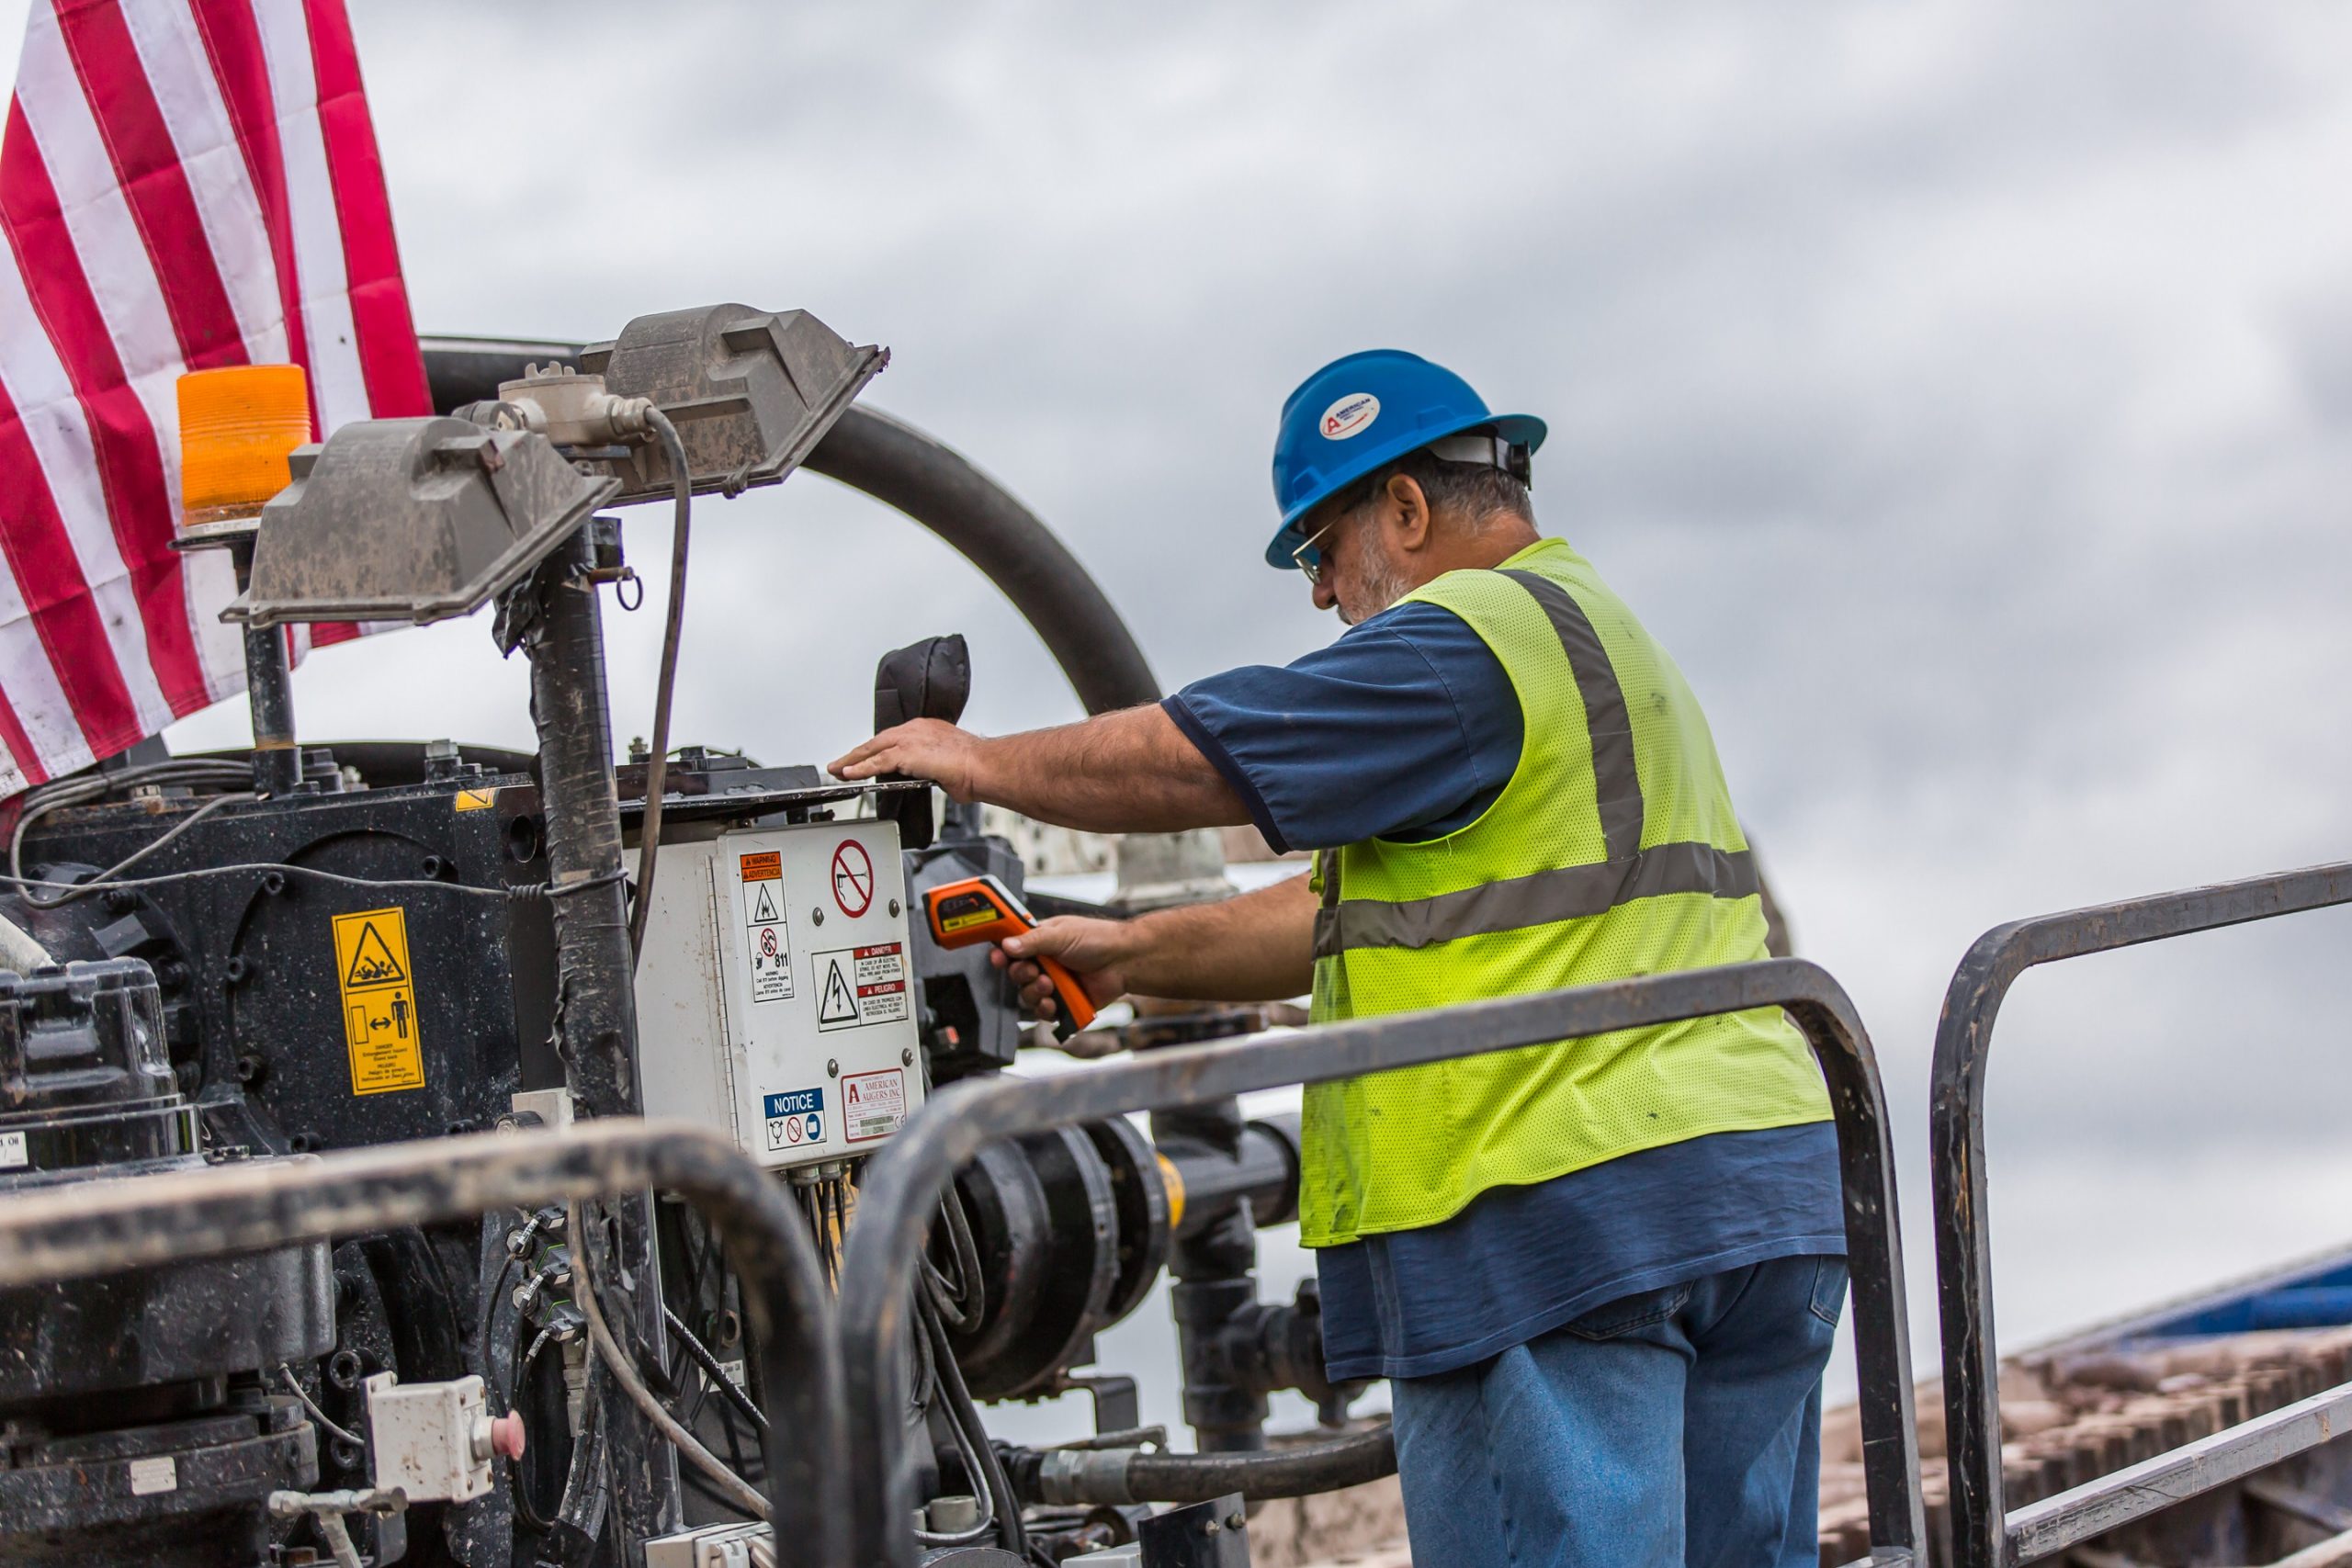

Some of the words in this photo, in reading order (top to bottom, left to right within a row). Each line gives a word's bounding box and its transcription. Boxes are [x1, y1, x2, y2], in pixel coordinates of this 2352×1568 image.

[752, 855, 776, 865] WARNING
[871, 945, 892, 955] DANGER
[775, 953, 788, 968] 811
[874, 984, 896, 993] PELIGRO
[865, 1078, 898, 1091] AMERICAN
[849, 1084, 860, 1103] A
[863, 1090, 888, 1101] AUGERS
[888, 1088, 900, 1098] INC
[774, 1093, 814, 1113] NOTICE
